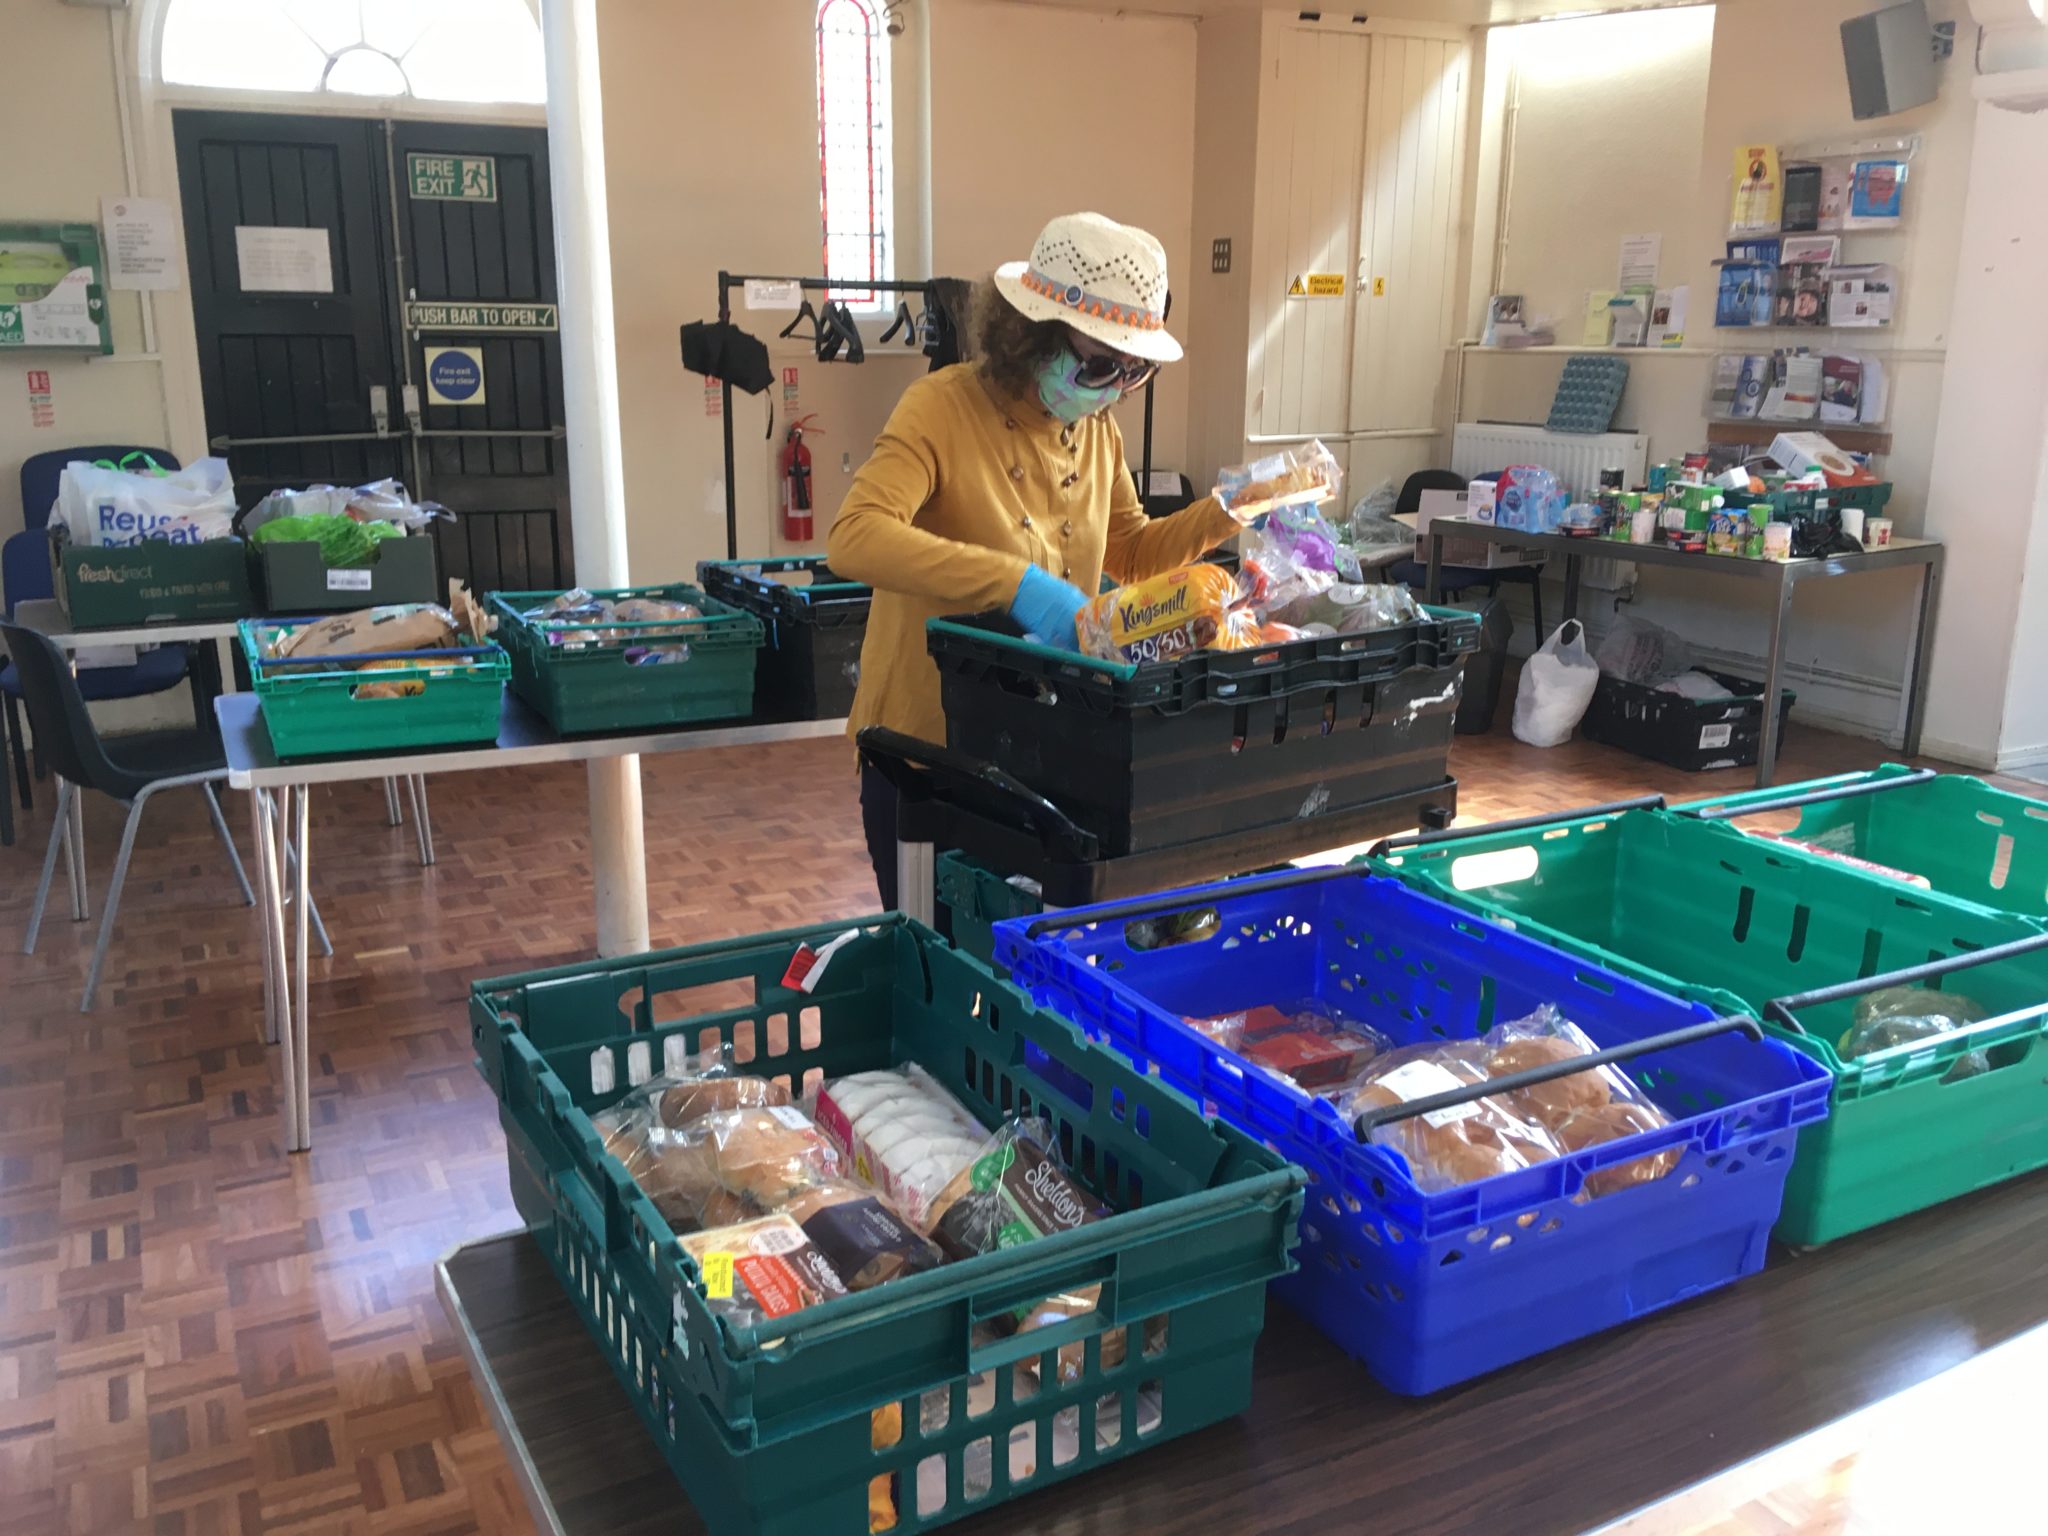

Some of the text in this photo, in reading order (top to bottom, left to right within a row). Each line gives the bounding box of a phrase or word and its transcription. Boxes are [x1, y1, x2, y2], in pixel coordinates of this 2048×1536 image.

[415, 158, 455, 176] FIRE
[416, 178, 455, 194] EXIT
[1310, 276, 1343, 285] Electrical
[1313, 286, 1338, 295] hazard
[450, 308, 478, 324] BAR
[481, 308, 499, 324] TO
[502, 309, 536, 325] OPEN
[439, 367, 471, 375] Fire exit
[435, 377, 476, 386] keep clear
[99, 504, 172, 534] Reus
[102, 523, 202, 548] Rpeat
[1119, 585, 1189, 632] Kingsmill
[1130, 630, 1186, 663] 50/50
